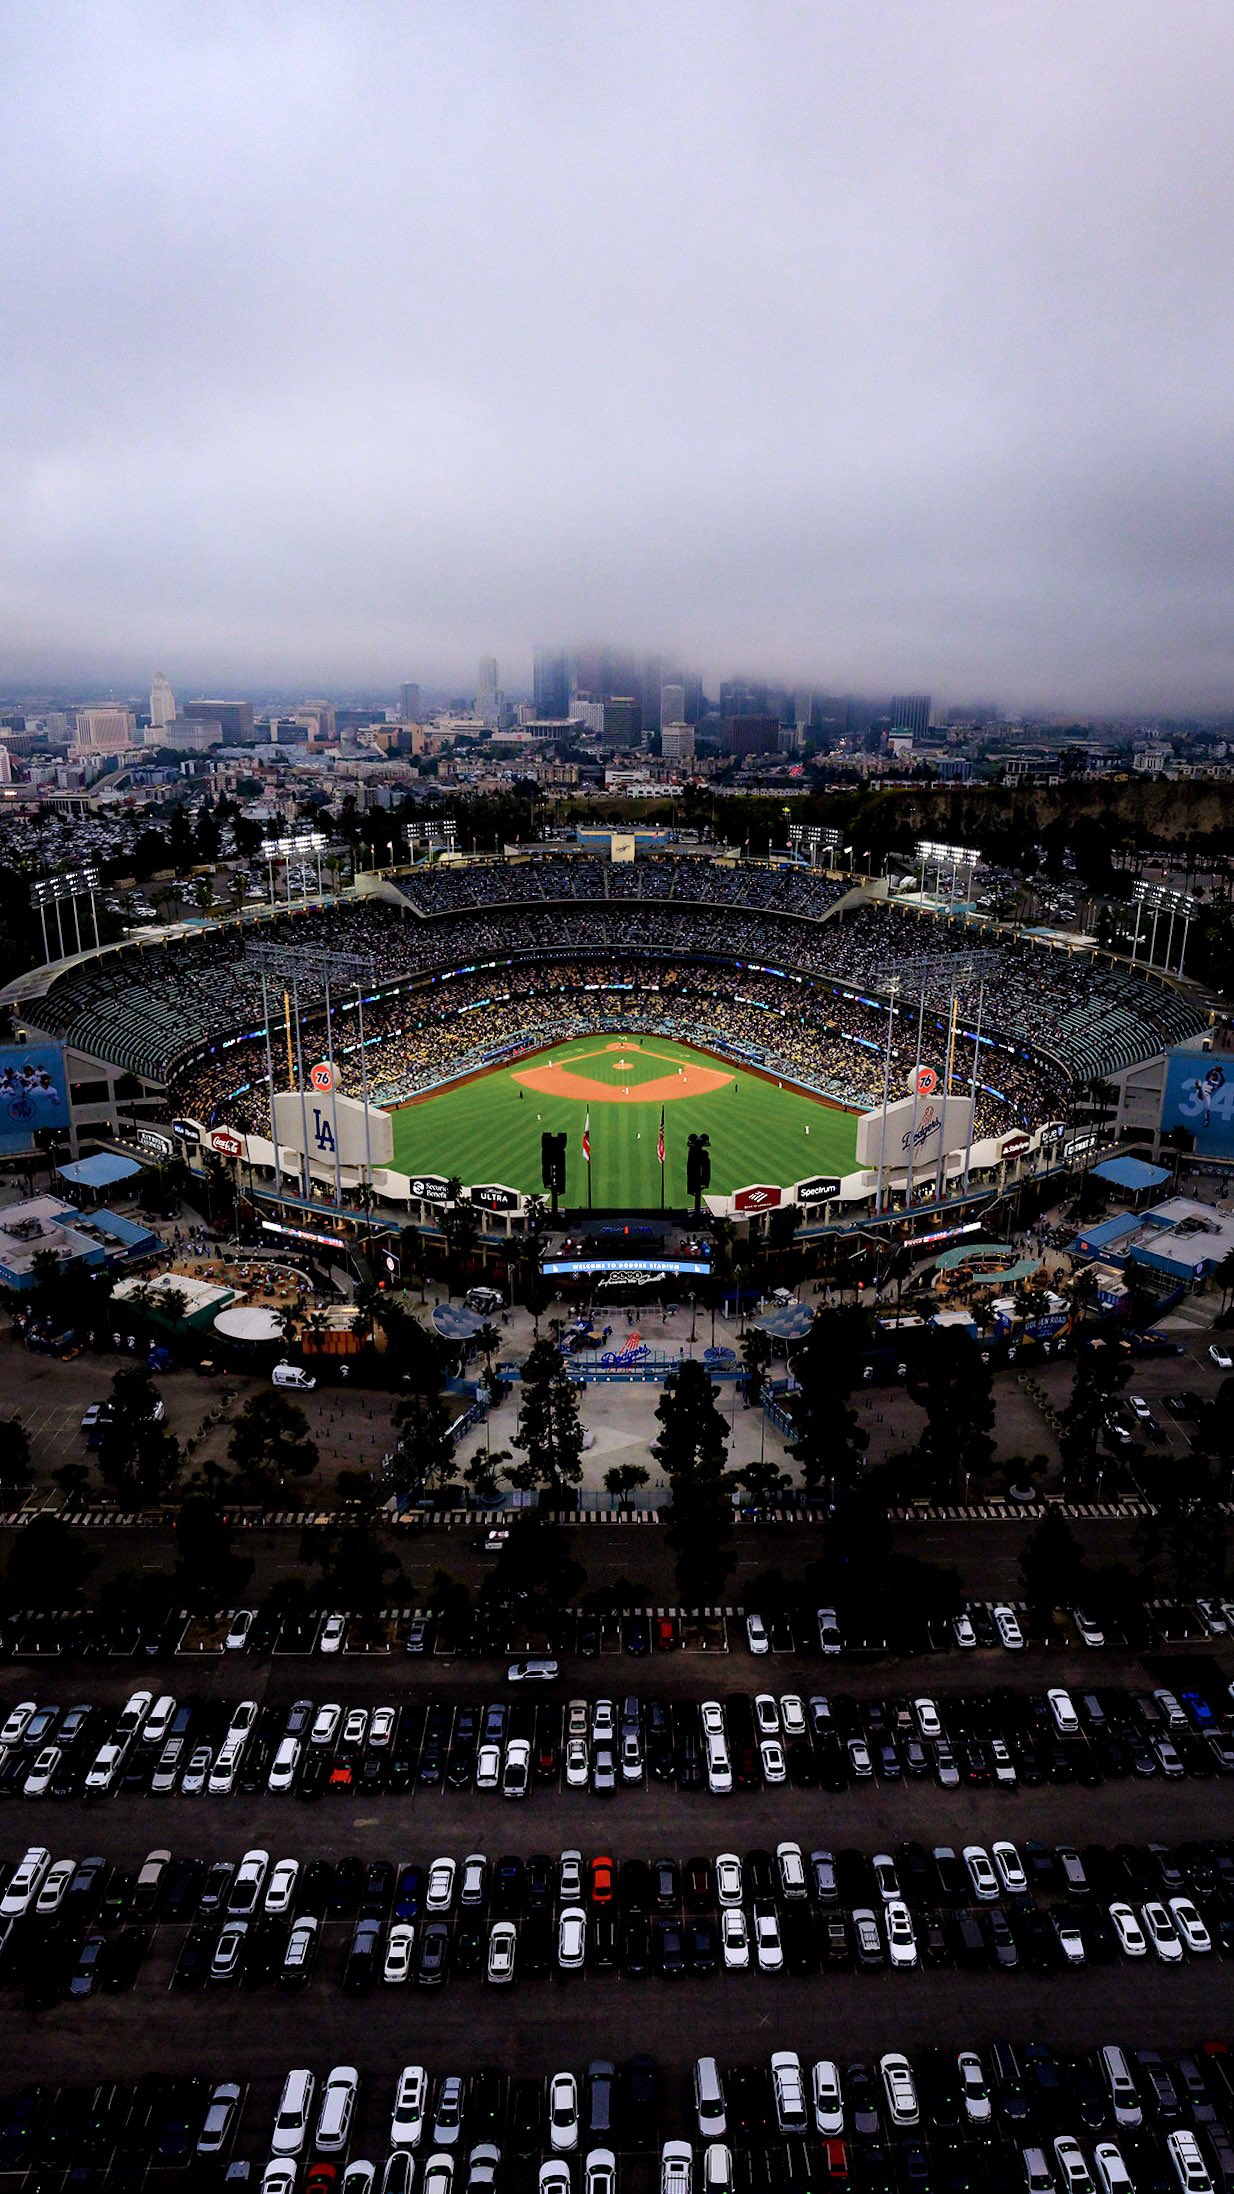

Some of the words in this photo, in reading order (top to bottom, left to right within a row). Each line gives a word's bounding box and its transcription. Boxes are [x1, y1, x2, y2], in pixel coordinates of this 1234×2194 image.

[316, 1072, 330, 1085] 76
[919, 1074, 933, 1088] 76
[1178, 1078, 1234, 1120] 34
[313, 1108, 335, 1152] LA
[902, 1117, 941, 1150] Dodgers
[426, 1183, 449, 1193] Securit
[427, 1190, 447, 1199] Benefit
[801, 1186, 835, 1197] Spectrum
[480, 1193, 508, 1203] ULTRA
[1025, 1318, 1049, 1330] GOLEN
[1050, 1316, 1067, 1324] ROAD
[600, 1344, 651, 1368] Dodgers
